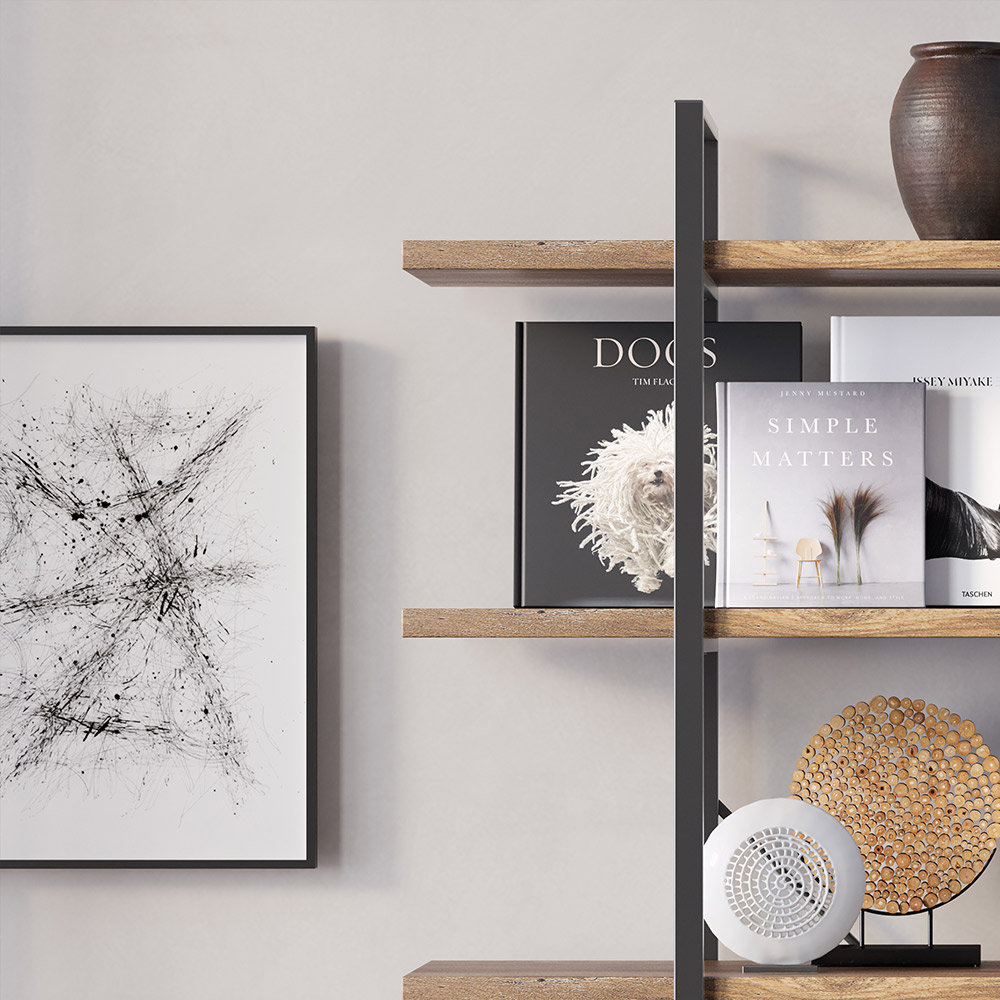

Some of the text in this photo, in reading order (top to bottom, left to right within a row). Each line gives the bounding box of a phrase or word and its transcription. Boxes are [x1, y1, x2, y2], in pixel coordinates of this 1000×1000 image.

[632, 378, 651, 386] TIM
[948, 376, 992, 386] MIYAKE
[768, 417, 878, 434] SIMPLE
[752, 450, 894, 467] MATTERS
